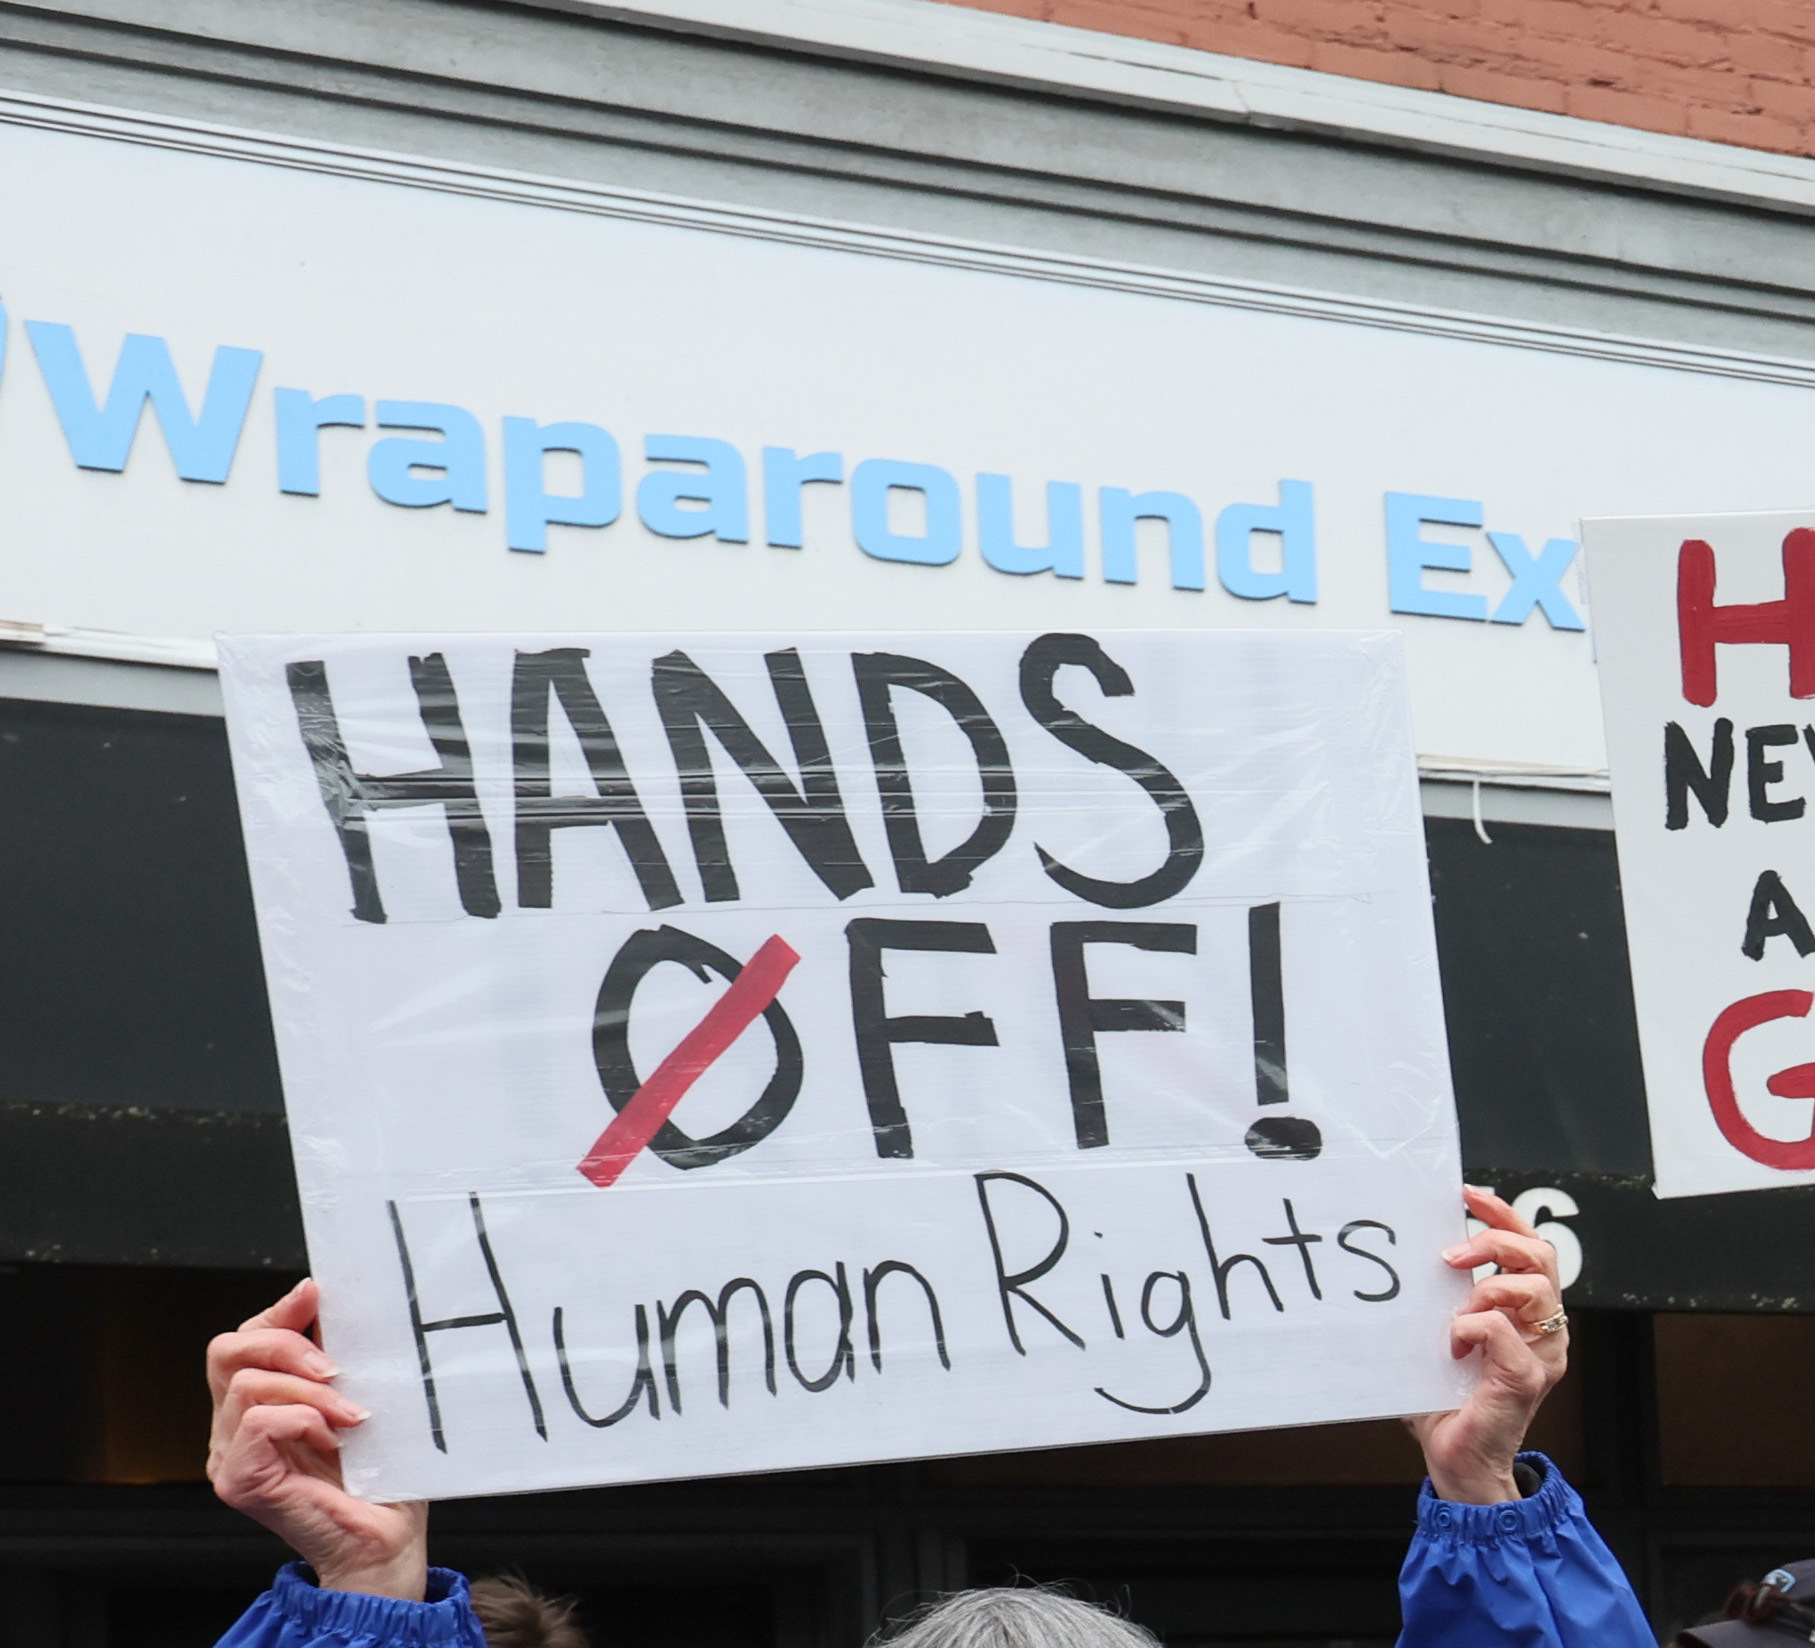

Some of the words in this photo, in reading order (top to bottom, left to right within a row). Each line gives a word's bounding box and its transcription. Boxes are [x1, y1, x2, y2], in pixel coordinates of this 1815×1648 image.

[24, 318, 1317, 603] Wraparound
[1384, 491, 1585, 632] Ex
[286, 632, 1205, 925] HANDS
[386, 1190, 951, 1453] Human
[974, 1170, 1403, 1416] Rights
